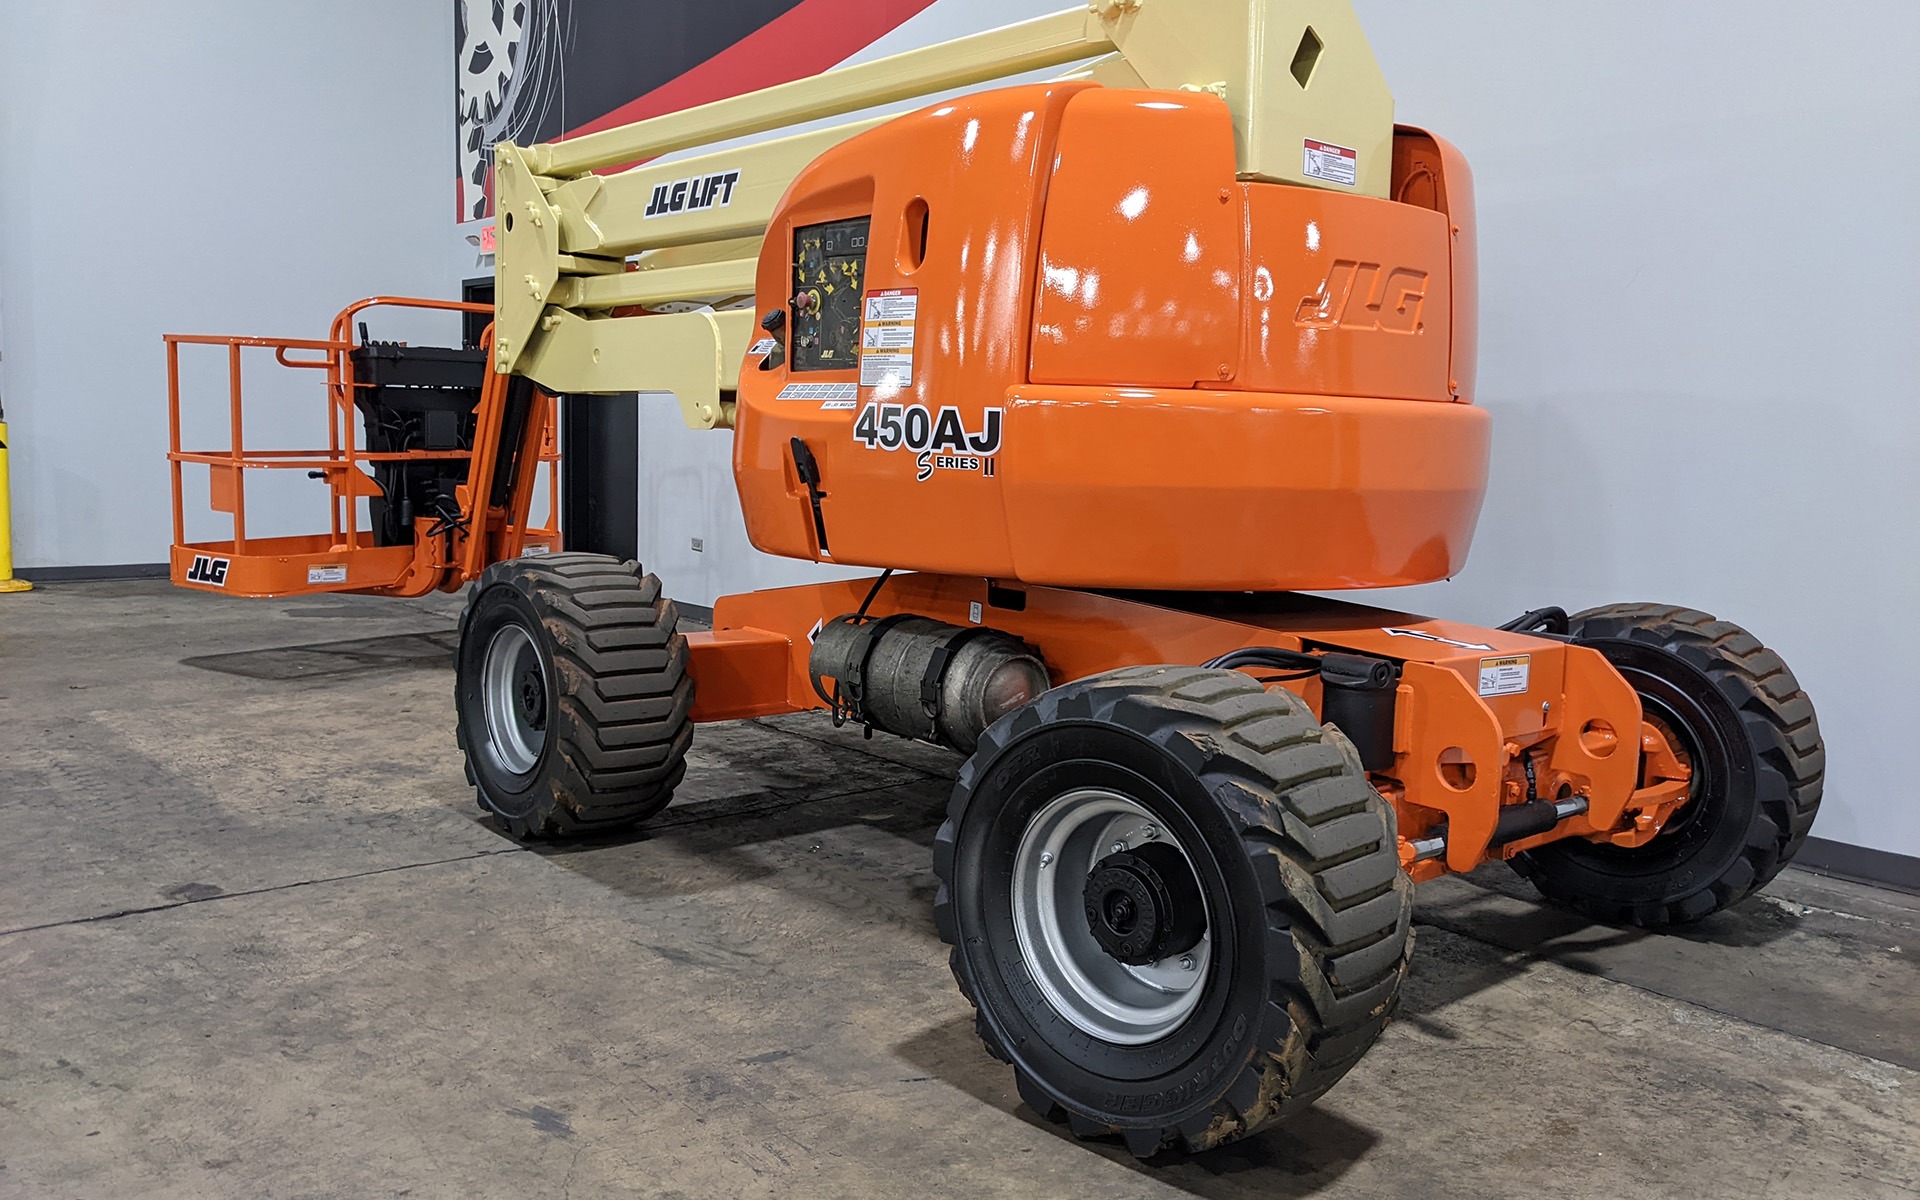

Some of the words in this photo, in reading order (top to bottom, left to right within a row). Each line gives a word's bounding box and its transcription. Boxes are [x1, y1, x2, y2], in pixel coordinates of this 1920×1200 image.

[645, 181, 688, 216] JLG
[687, 171, 739, 209] LIFT
[1293, 259, 1429, 335] JLG
[855, 405, 1001, 453] 450AJ
[917, 451, 979, 480] SERIES
[983, 458, 995, 477] II
[187, 556, 229, 585] JLG
